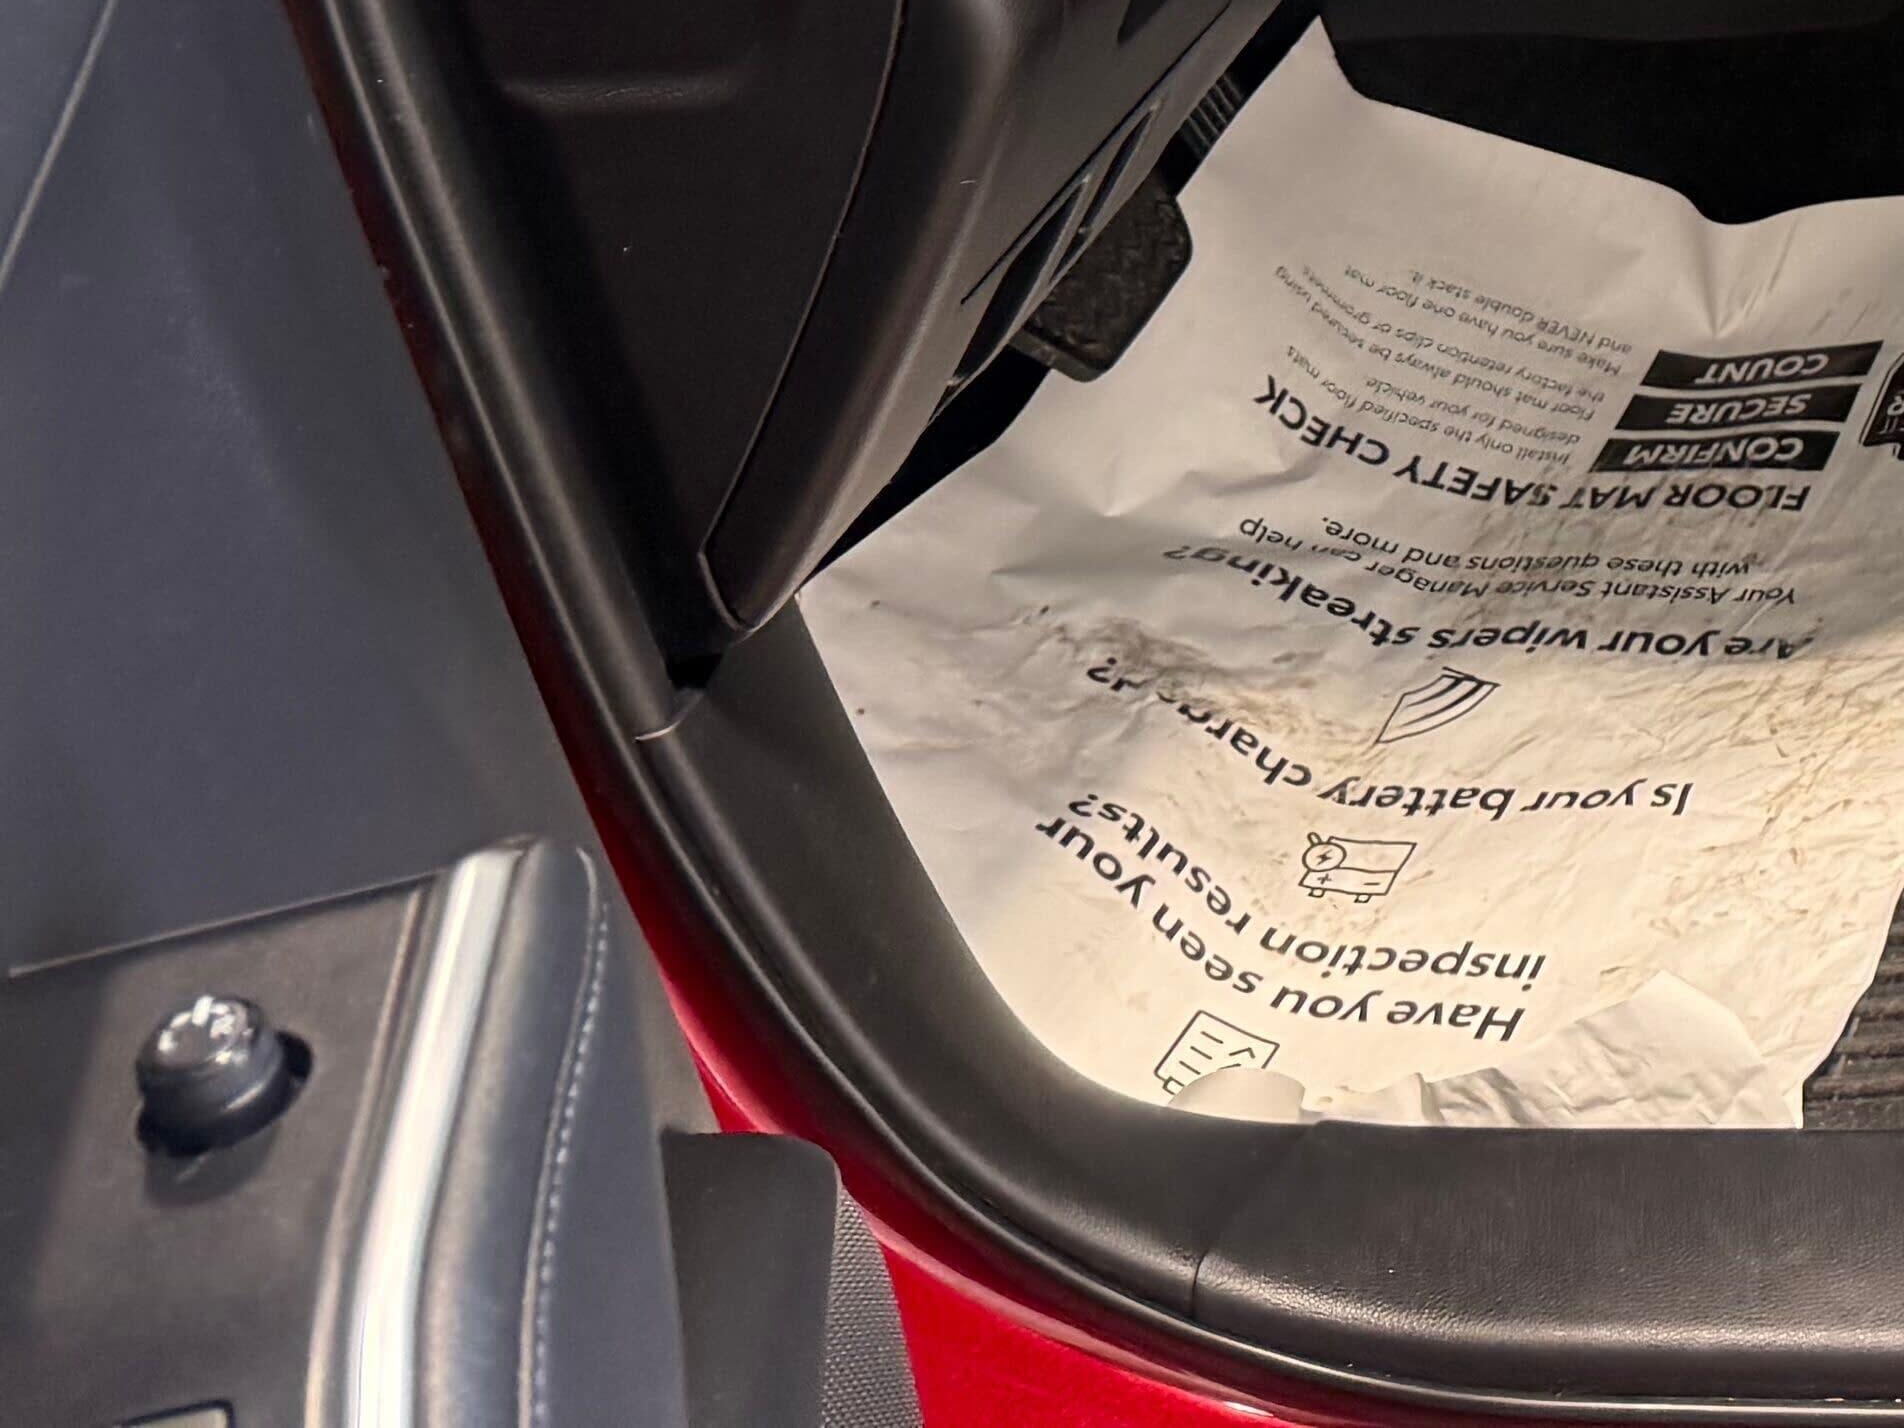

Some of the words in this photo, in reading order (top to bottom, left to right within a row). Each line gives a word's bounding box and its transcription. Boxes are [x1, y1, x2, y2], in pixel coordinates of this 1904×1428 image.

[1375, 285, 1418, 307] floor
[1421, 299, 1454, 316] one
[1473, 294, 1534, 322] double
[1457, 311, 1498, 336] have
[1500, 327, 1535, 344] you
[1535, 316, 1595, 344] NEVER
[1367, 343, 1391, 360] be
[1536, 340, 1572, 357] sure
[1596, 336, 1631, 353] and
[1394, 351, 1450, 378] always
[1436, 343, 1512, 374] retention
[1575, 351, 1621, 375] Make
[1694, 352, 1829, 383] COUNT
[1320, 378, 1357, 408] floor
[1452, 372, 1512, 395] should
[1513, 365, 1573, 395] factory
[1576, 386, 1604, 401] the
[1428, 400, 1469, 414] your
[1514, 391, 1548, 409] mat
[1550, 404, 1594, 420] Floor
[1665, 392, 1811, 424] SECURE
[1250, 373, 1389, 466] CHECK
[1355, 399, 1438, 431] specified
[1470, 410, 1496, 427] for
[1442, 424, 1472, 442] the
[1474, 433, 1513, 454] only
[1497, 418, 1580, 445] designed
[1515, 446, 1569, 463] Install
[1623, 436, 1804, 464] CONFIRM
[1391, 453, 1556, 506] SAFETY
[1558, 483, 1655, 509] MAT
[1661, 482, 1811, 511] FLOOR
[1237, 516, 1302, 550] help
[1319, 515, 1399, 555] more.
[1310, 544, 1360, 563] can
[1399, 546, 1460, 569] and
[1464, 551, 1598, 572] questions
[1606, 555, 1682, 576] these
[1363, 560, 1489, 597] Manager
[1690, 560, 1749, 578] with
[1160, 545, 1419, 647] streaking?
[1494, 579, 1595, 596] Service
[1599, 581, 1728, 604] Assistant
[1732, 586, 1796, 604] Your
[1426, 619, 1587, 653] wipers
[1596, 628, 1720, 657] your
[1723, 635, 1813, 659] Are
[1316, 774, 1515, 820] battery
[1519, 778, 1647, 811] your
[1649, 781, 1693, 815] Is
[1034, 815, 1154, 910] your
[1067, 792, 1251, 934] results?
[1150, 902, 1263, 994] seen
[1258, 925, 1545, 990] inspection
[1268, 984, 1382, 1022] you
[1385, 999, 1524, 1041] Have
